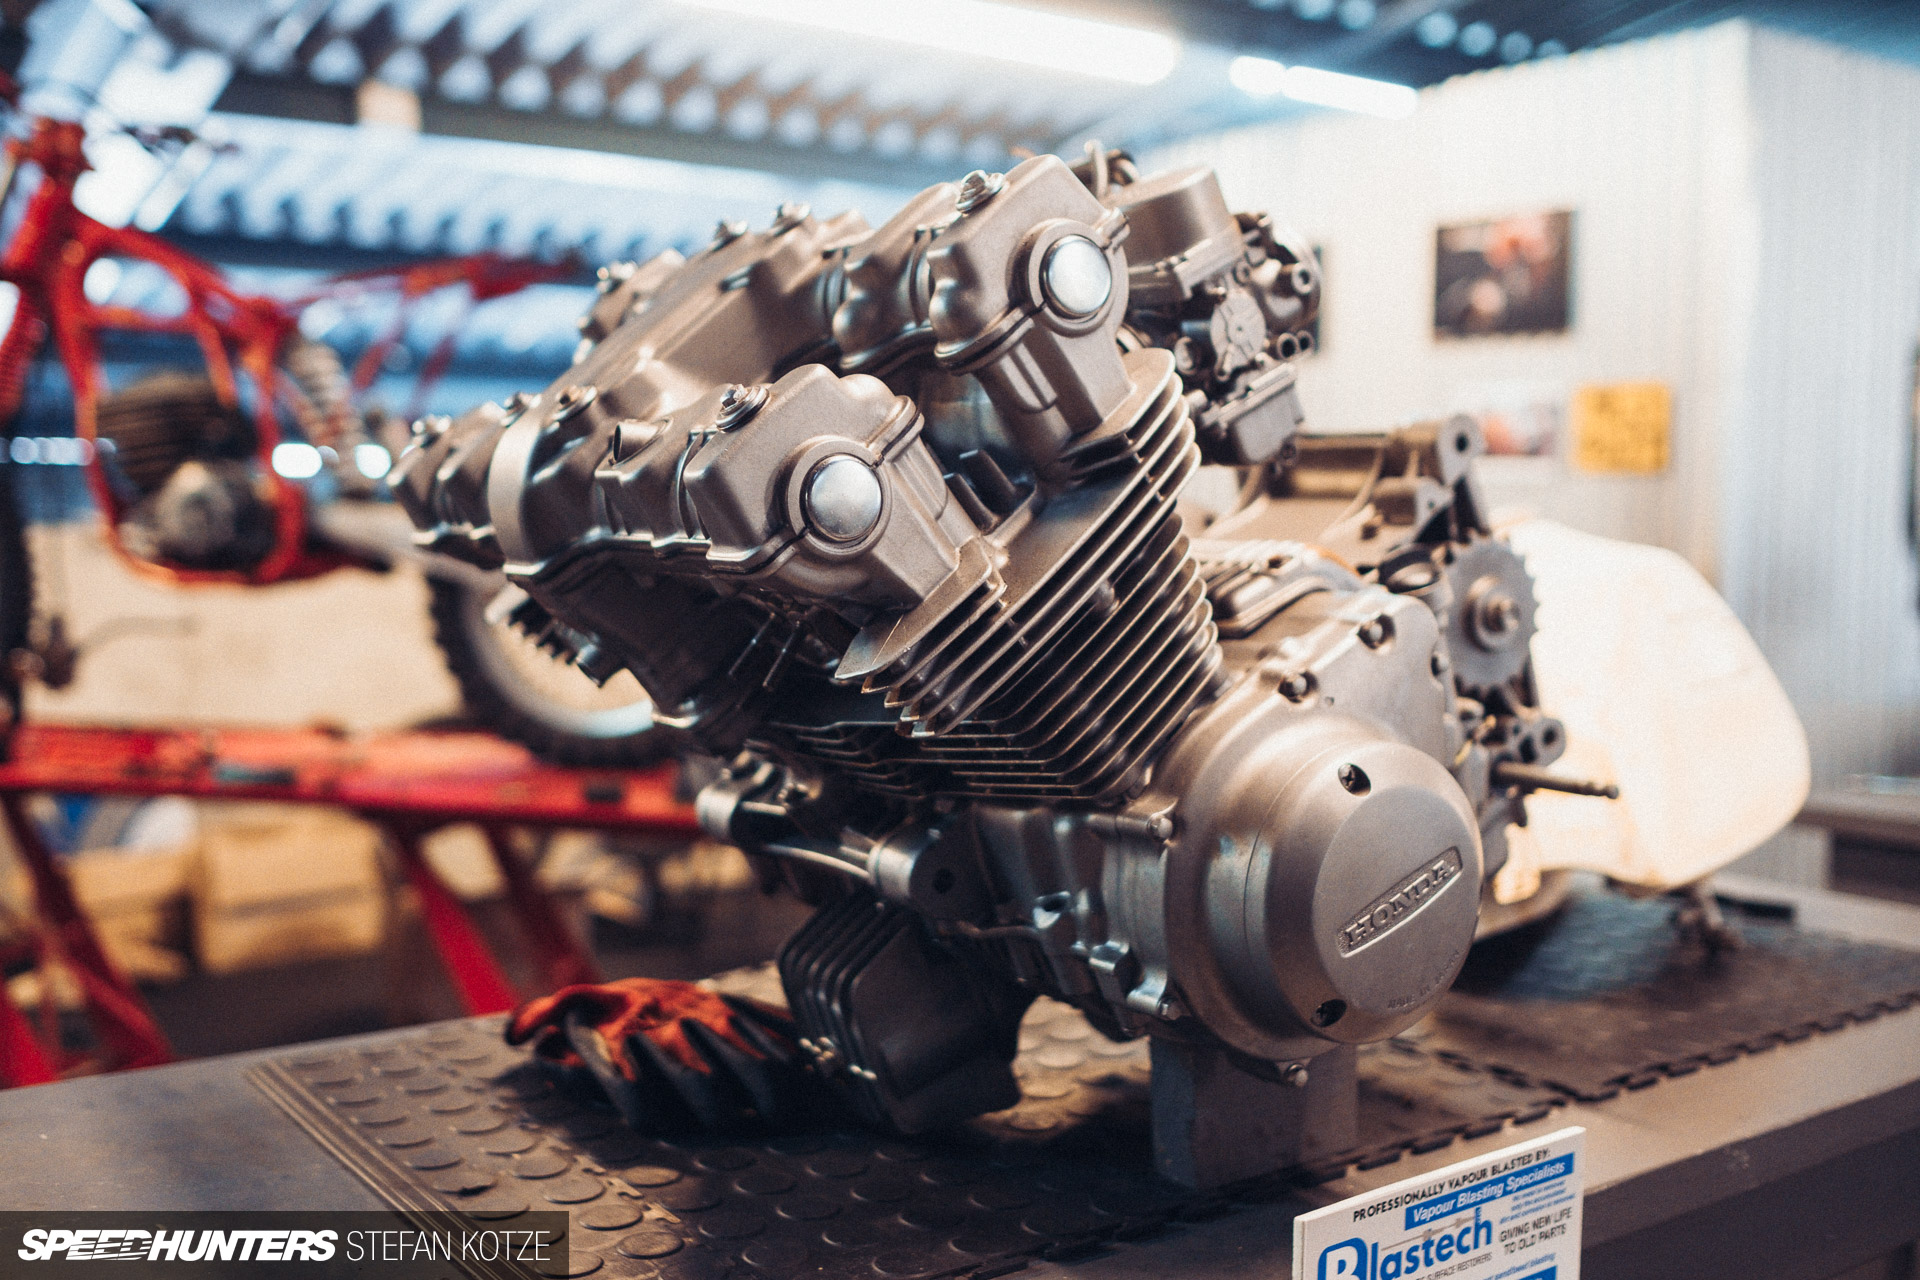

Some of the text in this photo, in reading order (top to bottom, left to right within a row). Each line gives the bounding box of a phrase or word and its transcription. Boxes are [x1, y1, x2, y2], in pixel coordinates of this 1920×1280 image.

[1344, 859, 1456, 947] HONDA
[1352, 1181, 1446, 1223] PROFESSIONALLY
[1448, 1167, 1488, 1190] VAPOUR
[1491, 1153, 1534, 1176] BLASTED
[1413, 1199, 1457, 1223] Vapour
[1456, 1183, 1505, 1208] Blasting
[1505, 1162, 1566, 1193] Specialists
[1499, 1222, 1530, 1242] GIVING
[1532, 1215, 1551, 1231] NEW
[1553, 1207, 1573, 1223] LIFE
[1504, 1223, 1566, 1255] TO OLD PARTS
